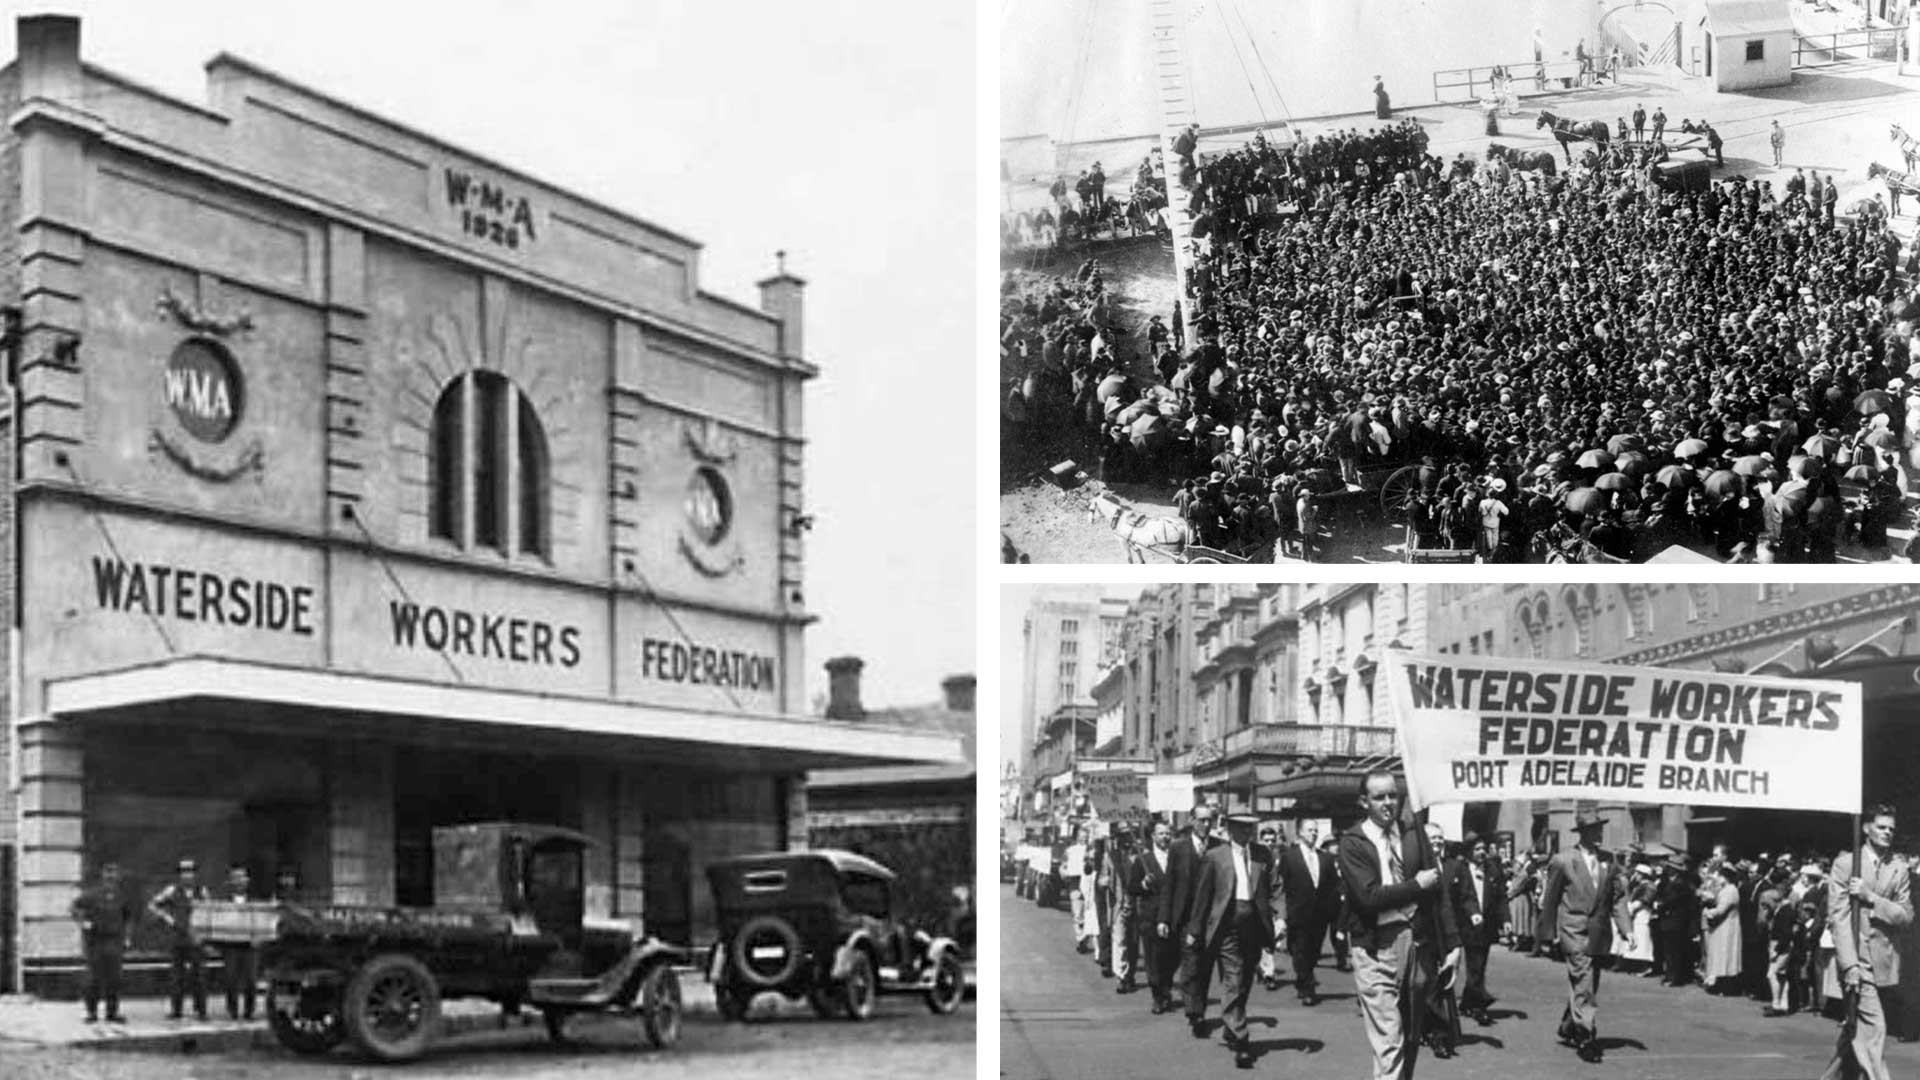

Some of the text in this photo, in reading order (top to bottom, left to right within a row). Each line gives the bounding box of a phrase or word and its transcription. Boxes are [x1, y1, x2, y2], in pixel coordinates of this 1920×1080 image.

[164, 368, 231, 419] WMA
[93, 556, 776, 693] WATERSIDE WORKERS FEDERATION
[1404, 664, 1842, 731] WATERSIDE WORKERS
[1478, 716, 1746, 764] FEDERATION
[1451, 759, 1770, 796] PORT ADELAIDE BRANCH
